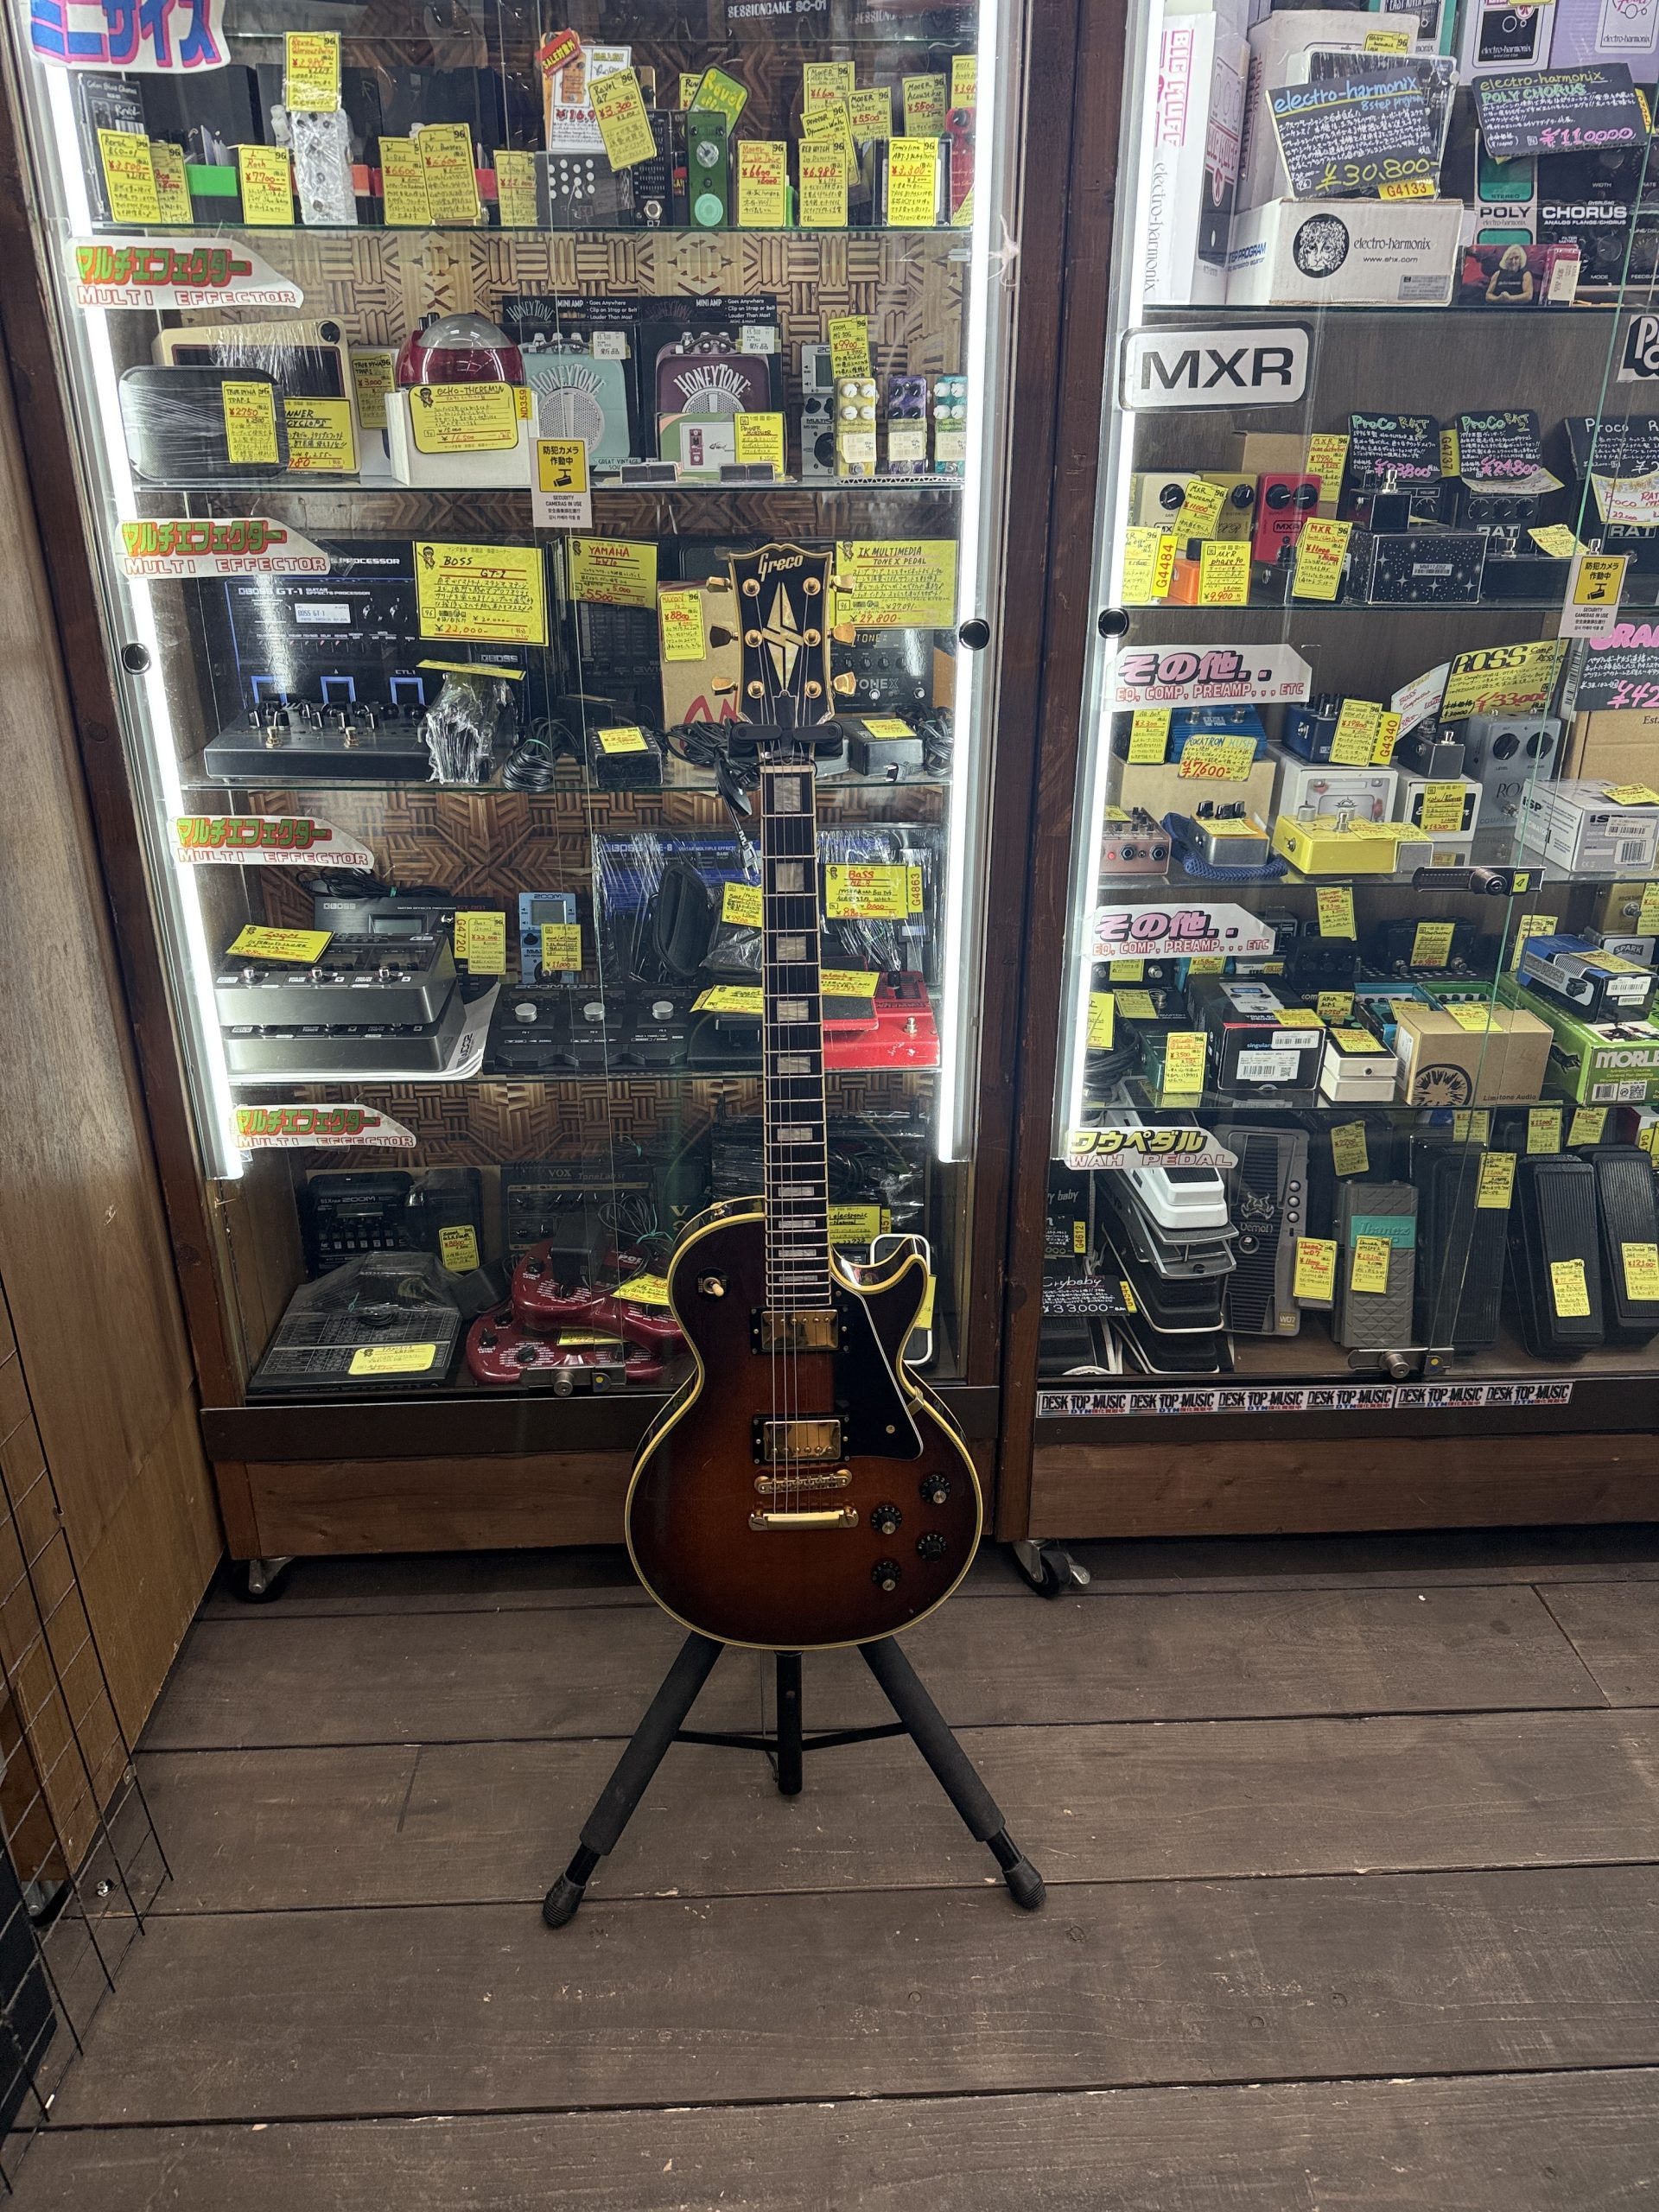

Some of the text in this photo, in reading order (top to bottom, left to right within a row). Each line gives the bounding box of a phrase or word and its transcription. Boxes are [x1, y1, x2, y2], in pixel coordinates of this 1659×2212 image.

[1162, 29, 1192, 149] BIG MUFF
[1480, 70, 1605, 92] electro-harmonix
[1274, 74, 1419, 113] electro-harmonix
[1481, 83, 1586, 105] POLY CHORUS
[1387, 181, 1428, 198] G4133
[1480, 207, 1530, 219] POLY
[1541, 207, 1627, 219] CHORUS
[1143, 161, 1165, 291] electro-harmonix
[1354, 236, 1431, 251] electro-harmonix
[76, 246, 253, 287] マルチエフェクター
[78, 286, 296, 306] MULTI EFFECTOR
[557, 299, 584, 308] MINI AMP
[696, 298, 722, 308] MINI AMP
[505, 300, 555, 324] HONEYTONE
[600, 347, 620, 357] 新品
[1141, 347, 1294, 390] MXR
[527, 362, 606, 398] HONEYTONE
[673, 363, 753, 397] HONEYTONE
[520, 389, 529, 418] ND359
[1351, 415, 1396, 430] ProCo
[1461, 415, 1505, 431] ProCo
[543, 446, 580, 456] 防犯カメラ
[1441, 436, 1452, 470] G4737
[550, 456, 574, 466] 作動中
[1310, 524, 1332, 534] MXR
[1608, 525, 1656, 537] RAT
[122, 520, 288, 556] マルチエフェクター
[588, 545, 630, 558] YAMAHA
[858, 545, 923, 557] IK MULTIMEDIA
[124, 556, 326, 575] MULTI EFFECTOR
[443, 556, 473, 566] BOSS
[758, 553, 804, 583] Greco
[903, 557, 928, 566] PEDAL
[1156, 543, 1173, 588] G4484
[1585, 562, 1619, 570] 防犯カメラ
[1590, 571, 1611, 580] 作動中
[662, 594, 684, 603] MAXON
[1452, 645, 1529, 676] ROSS
[1280, 682, 1304, 696] ETC
[1187, 736, 1225, 747] ROCKTRON
[1379, 719, 1397, 758] G4340
[176, 818, 333, 849] マルチエフェクター
[178, 848, 368, 865] MULTI EFFECTOR
[912, 873, 921, 906] G4863
[456, 918, 466, 952] G4720
[1247, 938, 1269, 950] ETC
[1613, 944, 1643, 956] SPARK
[1595, 1050, 1659, 1069] MORLE
[237, 1108, 381, 1135] マルチエフェクター
[316, 1136, 414, 1148] EFFECTOR
[1069, 1129, 1208, 1155] ワウペダル
[1070, 1154, 1234, 1166] WAH PEDAL
[548, 1168, 572, 1178] VOX
[1058, 1189, 1079, 1202] baby
[1239, 1222, 1274, 1234] Demon
[1360, 1220, 1411, 1237] Ibanez
[1075, 1225, 1084, 1249] G4612
[1279, 1314, 1295, 1324] W07
[1042, 1393, 1126, 1409] DESK TOP MUSIC
[1129, 1392, 1214, 1408] DESK TOP MUSIC
[1218, 1391, 1303, 1408] DESK TOP MUSIC
[1307, 1388, 1392, 1405] DESK TOP MUSIC
[1399, 1386, 1483, 1403] DESK TOP MUSIC
[1486, 1384, 1569, 1401] DESK TOP MUSIC
